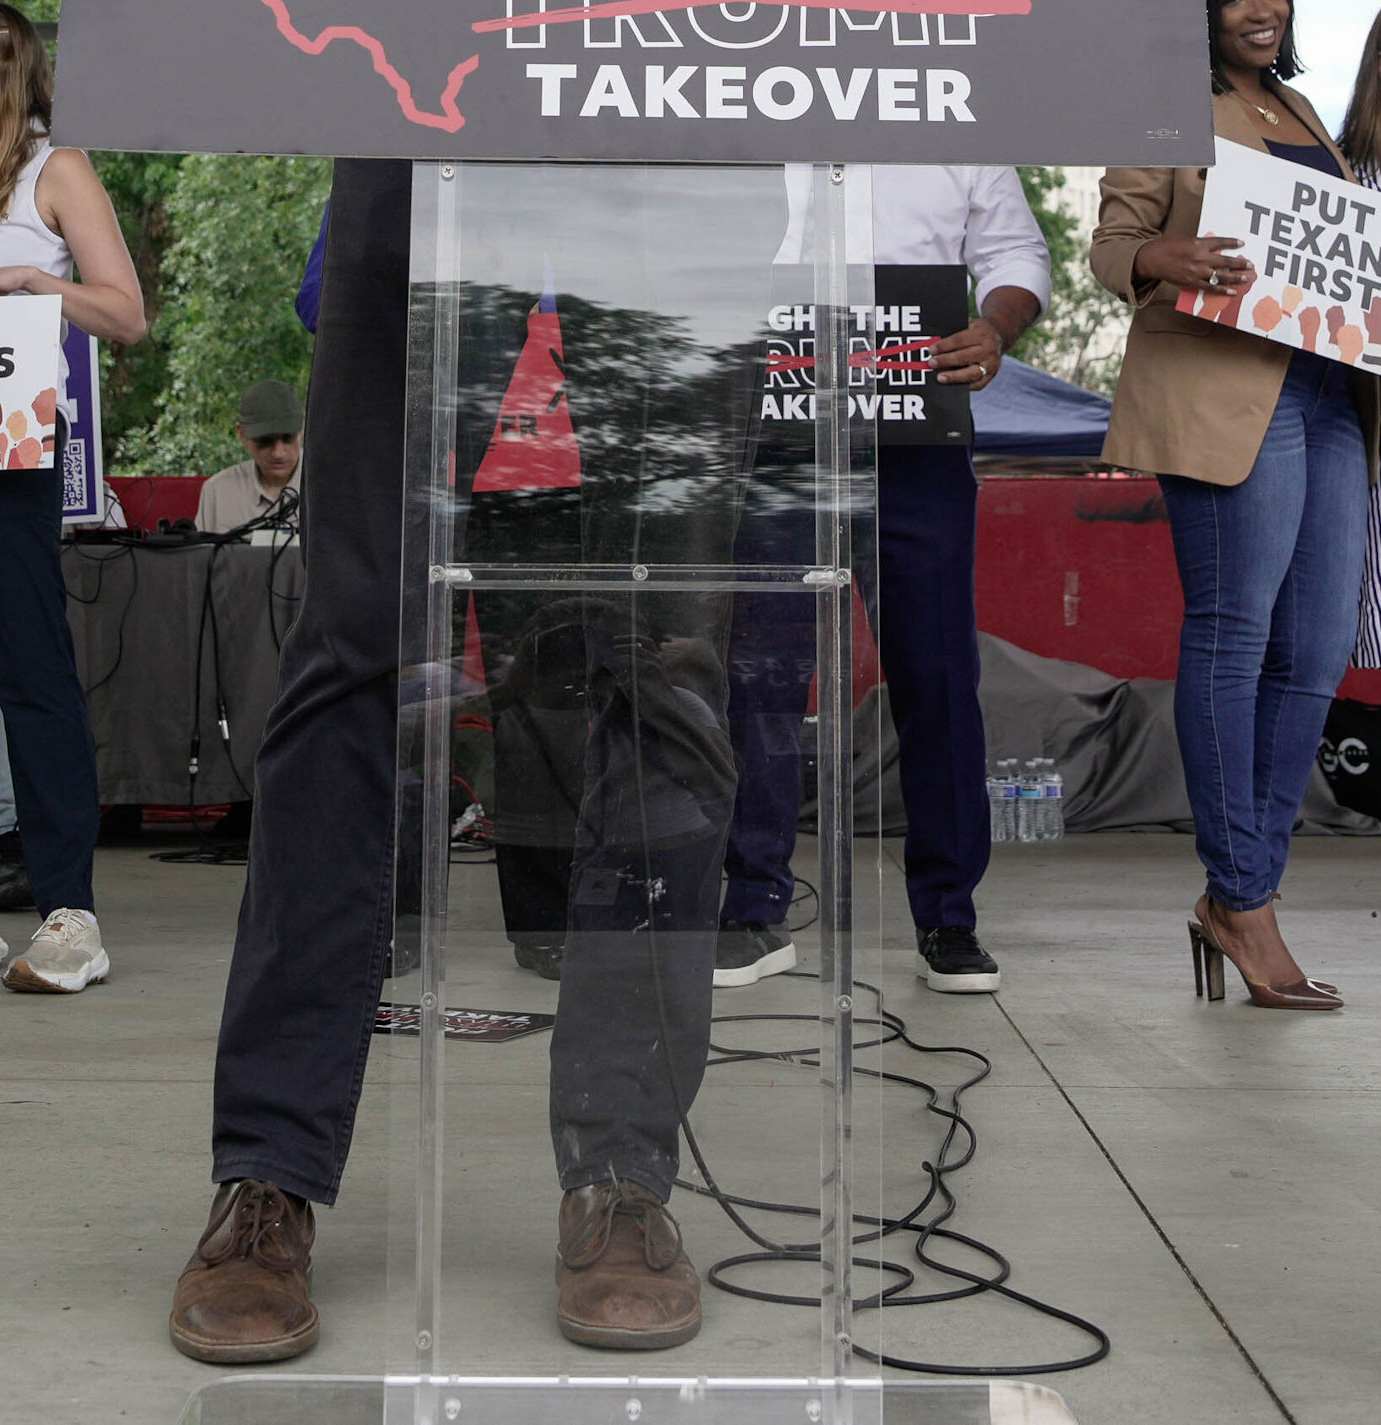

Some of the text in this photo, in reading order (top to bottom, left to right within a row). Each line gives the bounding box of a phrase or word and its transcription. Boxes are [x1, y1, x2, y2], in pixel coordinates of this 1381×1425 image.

[525, 63, 977, 122] TAKEOVER
[1291, 181, 1376, 235] PUT
[1264, 245, 1381, 311] FIRST
[849, 305, 921, 332] THE
